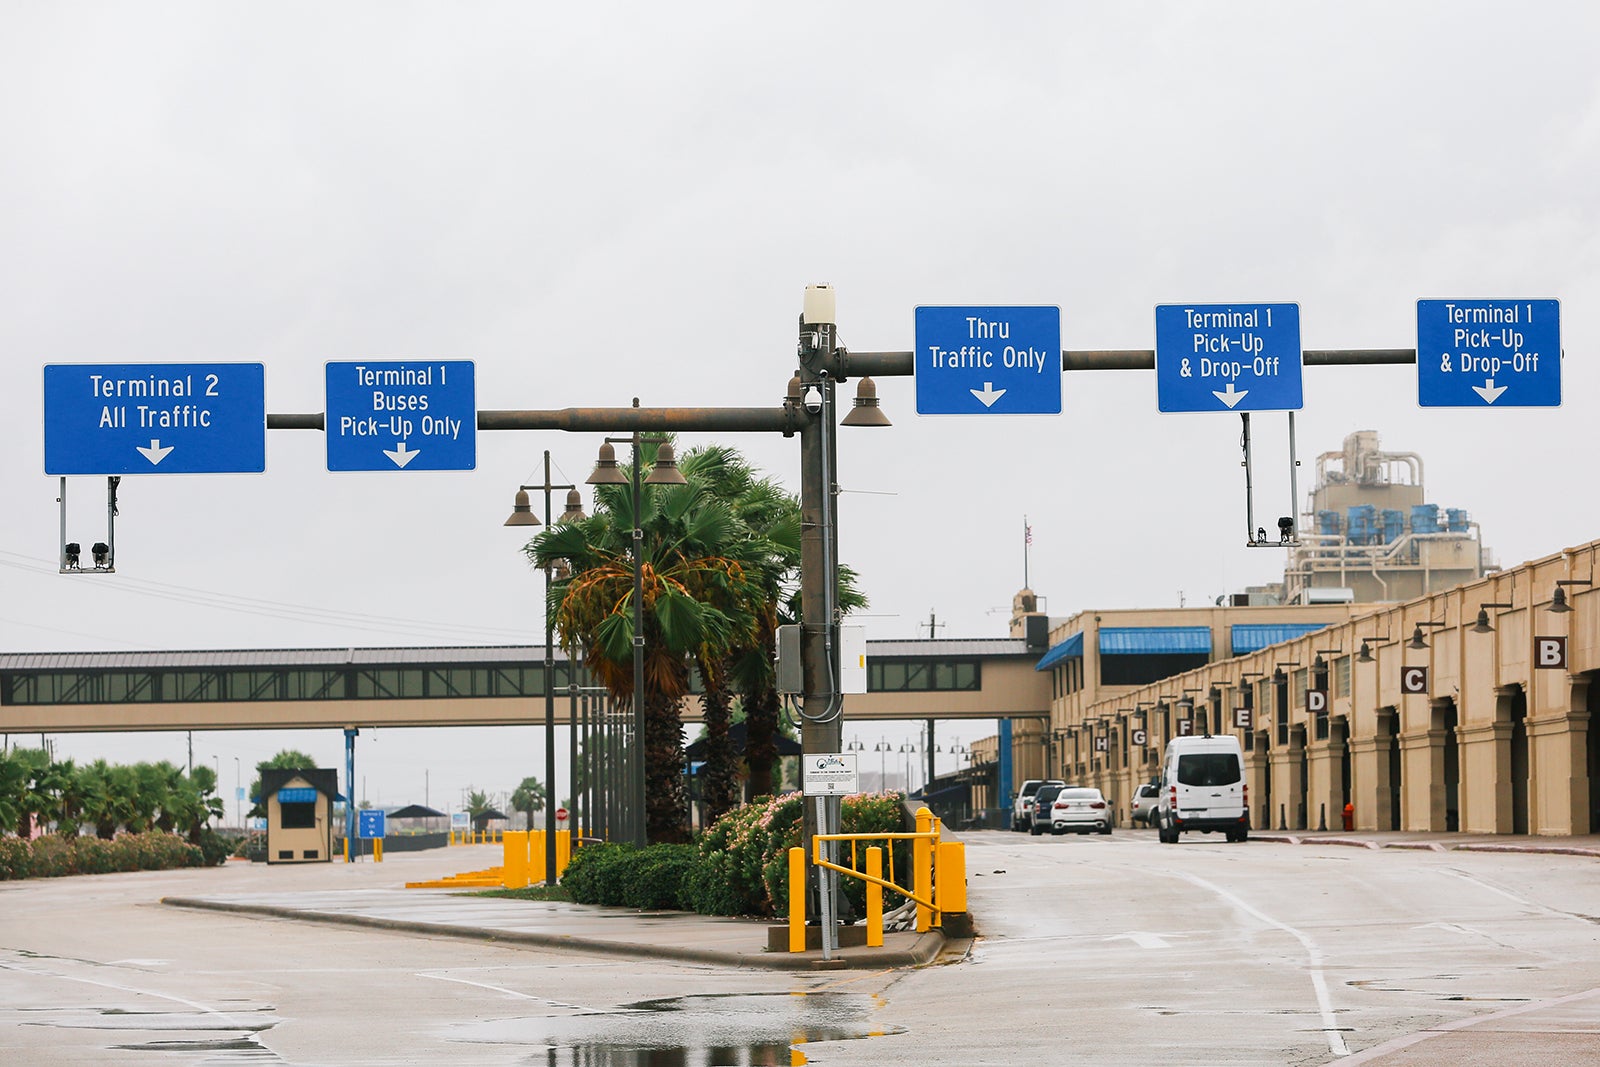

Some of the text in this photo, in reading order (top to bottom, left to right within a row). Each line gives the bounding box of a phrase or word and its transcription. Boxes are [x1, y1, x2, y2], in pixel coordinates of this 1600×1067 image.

[1184, 308, 1272, 329] Terminal 1
[1446, 304, 1532, 324] Terminal 1
[966, 317, 1009, 339] Thru
[1193, 333, 1264, 357] Pick-Up
[1455, 328, 1524, 352] Pick-Up
[929, 346, 1047, 374] Traffic Only
[1180, 355, 1280, 380] & Drop-Off
[1440, 350, 1539, 376] & Drop-Off
[90, 374, 219, 397] Terminal 2
[356, 366, 446, 386] Terminal 1
[373, 392, 429, 411] Buses
[99, 405, 212, 428] All Traffic
[340, 415, 461, 440] Pick-Up Only
[1540, 640, 1563, 665] B
[1404, 668, 1425, 692] C
[1309, 692, 1326, 710] D
[1180, 720, 1192, 734] F
[1237, 709, 1249, 726] E
[1096, 738, 1108, 750] H
[1133, 730, 1146, 745] G
